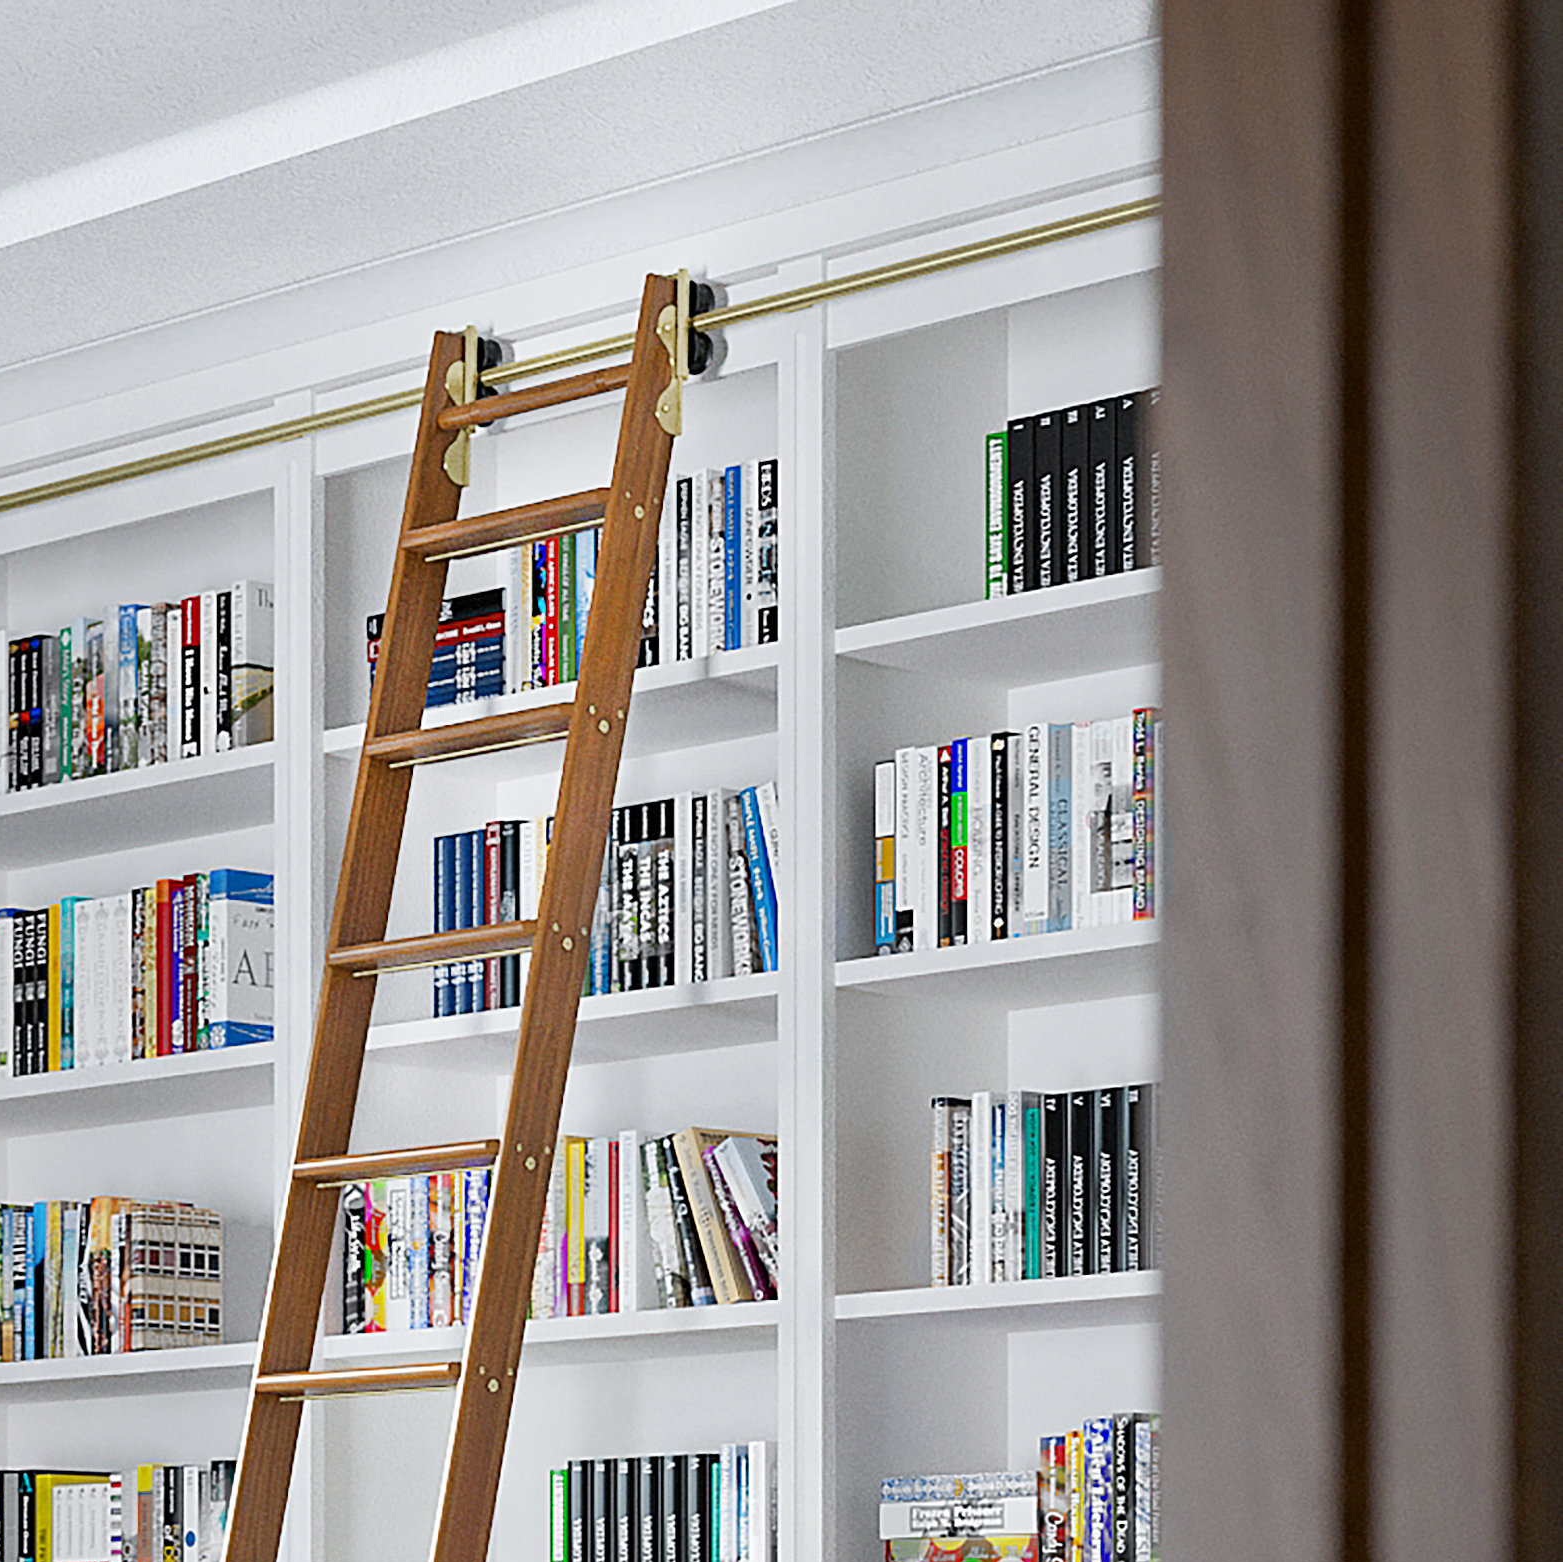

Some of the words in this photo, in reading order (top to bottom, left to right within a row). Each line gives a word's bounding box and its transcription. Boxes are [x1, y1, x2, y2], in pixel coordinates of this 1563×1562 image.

[1013, 480, 1024, 565] ENCYCLOPEDIA
[1040, 474, 1051, 559] ENCYCLOPEDIA
[1067, 468, 1078, 553] ENCYCLOPEDIA
[1095, 462, 1106, 547] ENCYCLOPEDIA
[1122, 456, 1134, 542] ENCYCLOPEDIA
[1028, 726, 1040, 803] GENERAL
[1028, 807, 1040, 869] DESIGN
[620, 859, 633, 892] THE
[639, 856, 651, 888] THE
[657, 849, 669, 882] THE
[25, 915, 35, 966] FUNGI
[37, 914, 46, 964] FUNGI
[639, 890, 651, 943] INCAS
[657, 884, 669, 945] AZTECS
[14, 917, 23, 968] FUNGI
[1117, 1416, 1128, 1473] SHADOWS
[1117, 1476, 1126, 1491] OF
[1117, 1496, 1126, 1515] THE
[1117, 1520, 1128, 1554] DEAD
